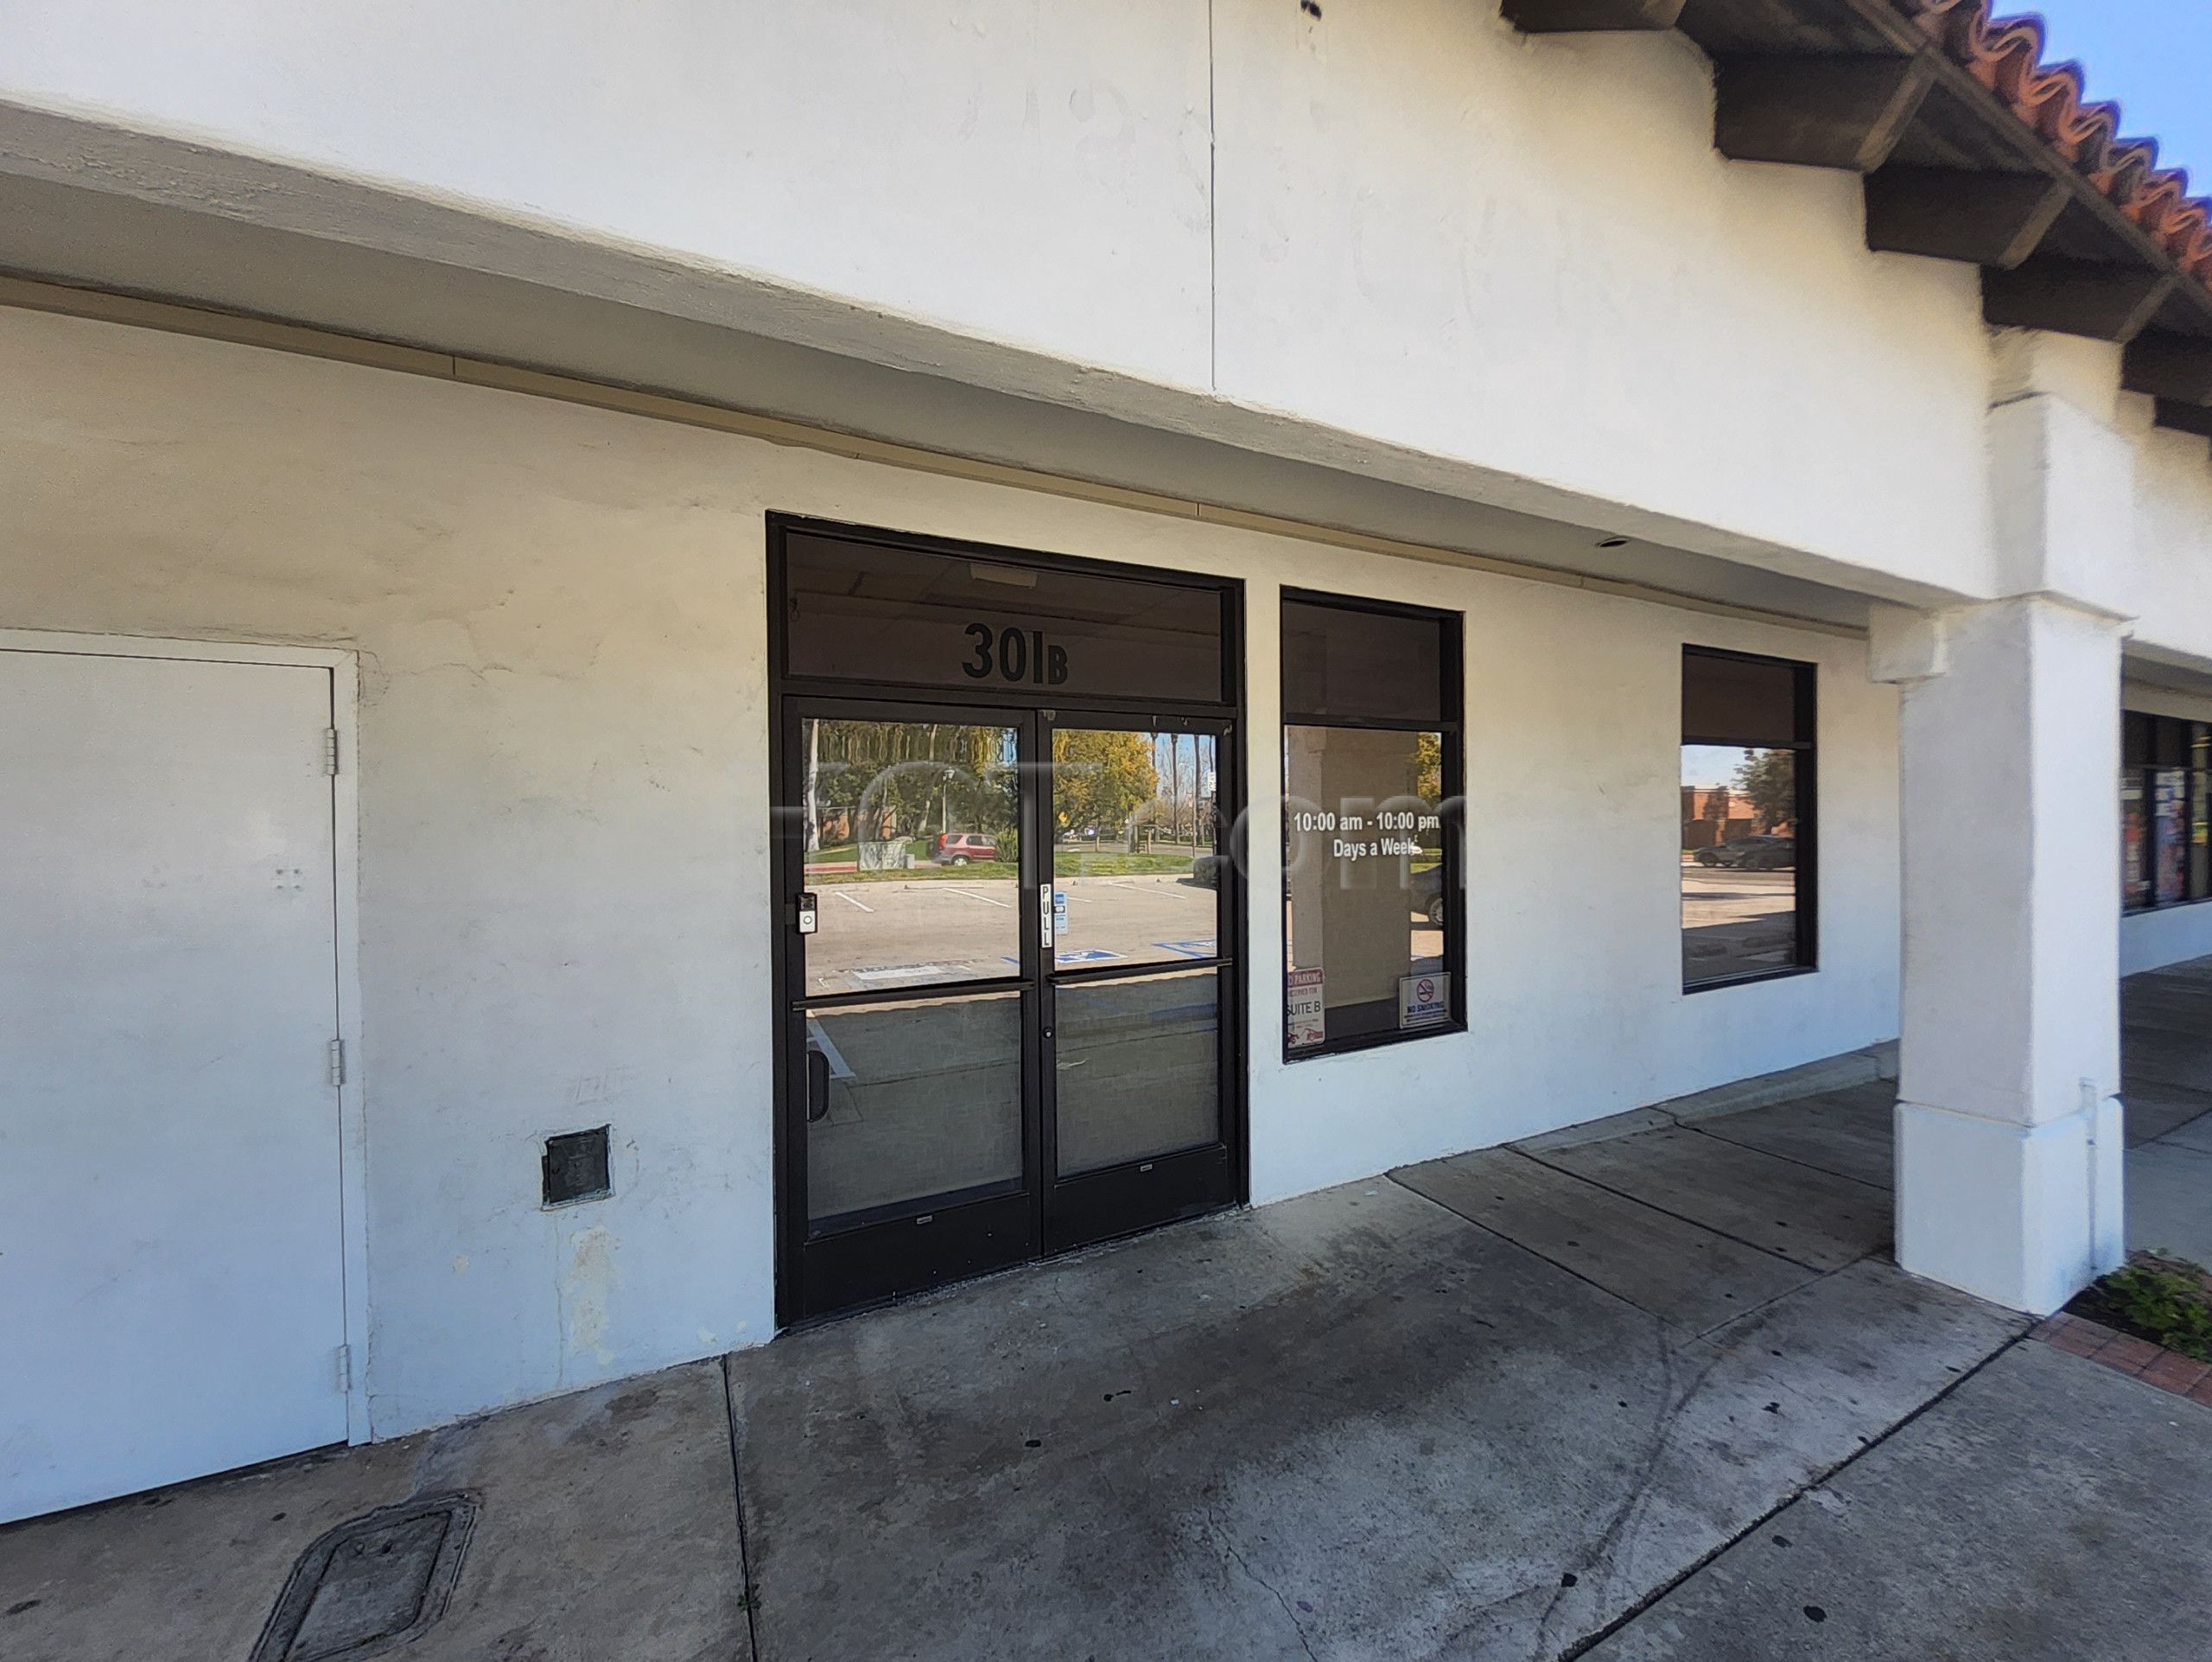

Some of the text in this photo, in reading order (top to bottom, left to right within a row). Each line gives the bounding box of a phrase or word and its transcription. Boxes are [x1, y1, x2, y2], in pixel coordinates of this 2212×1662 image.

[1294, 812, 1335, 831] 10:00
[1340, 816, 1363, 830] am
[1376, 812, 1414, 830] 10:00
[1418, 815, 1440, 831] pm
[1333, 837, 1416, 862] Days a Week
[1294, 972, 1321, 984] PARKING
[1287, 1000, 1320, 1016] SUITE B
[1417, 1002, 1445, 1011] SMOKING
